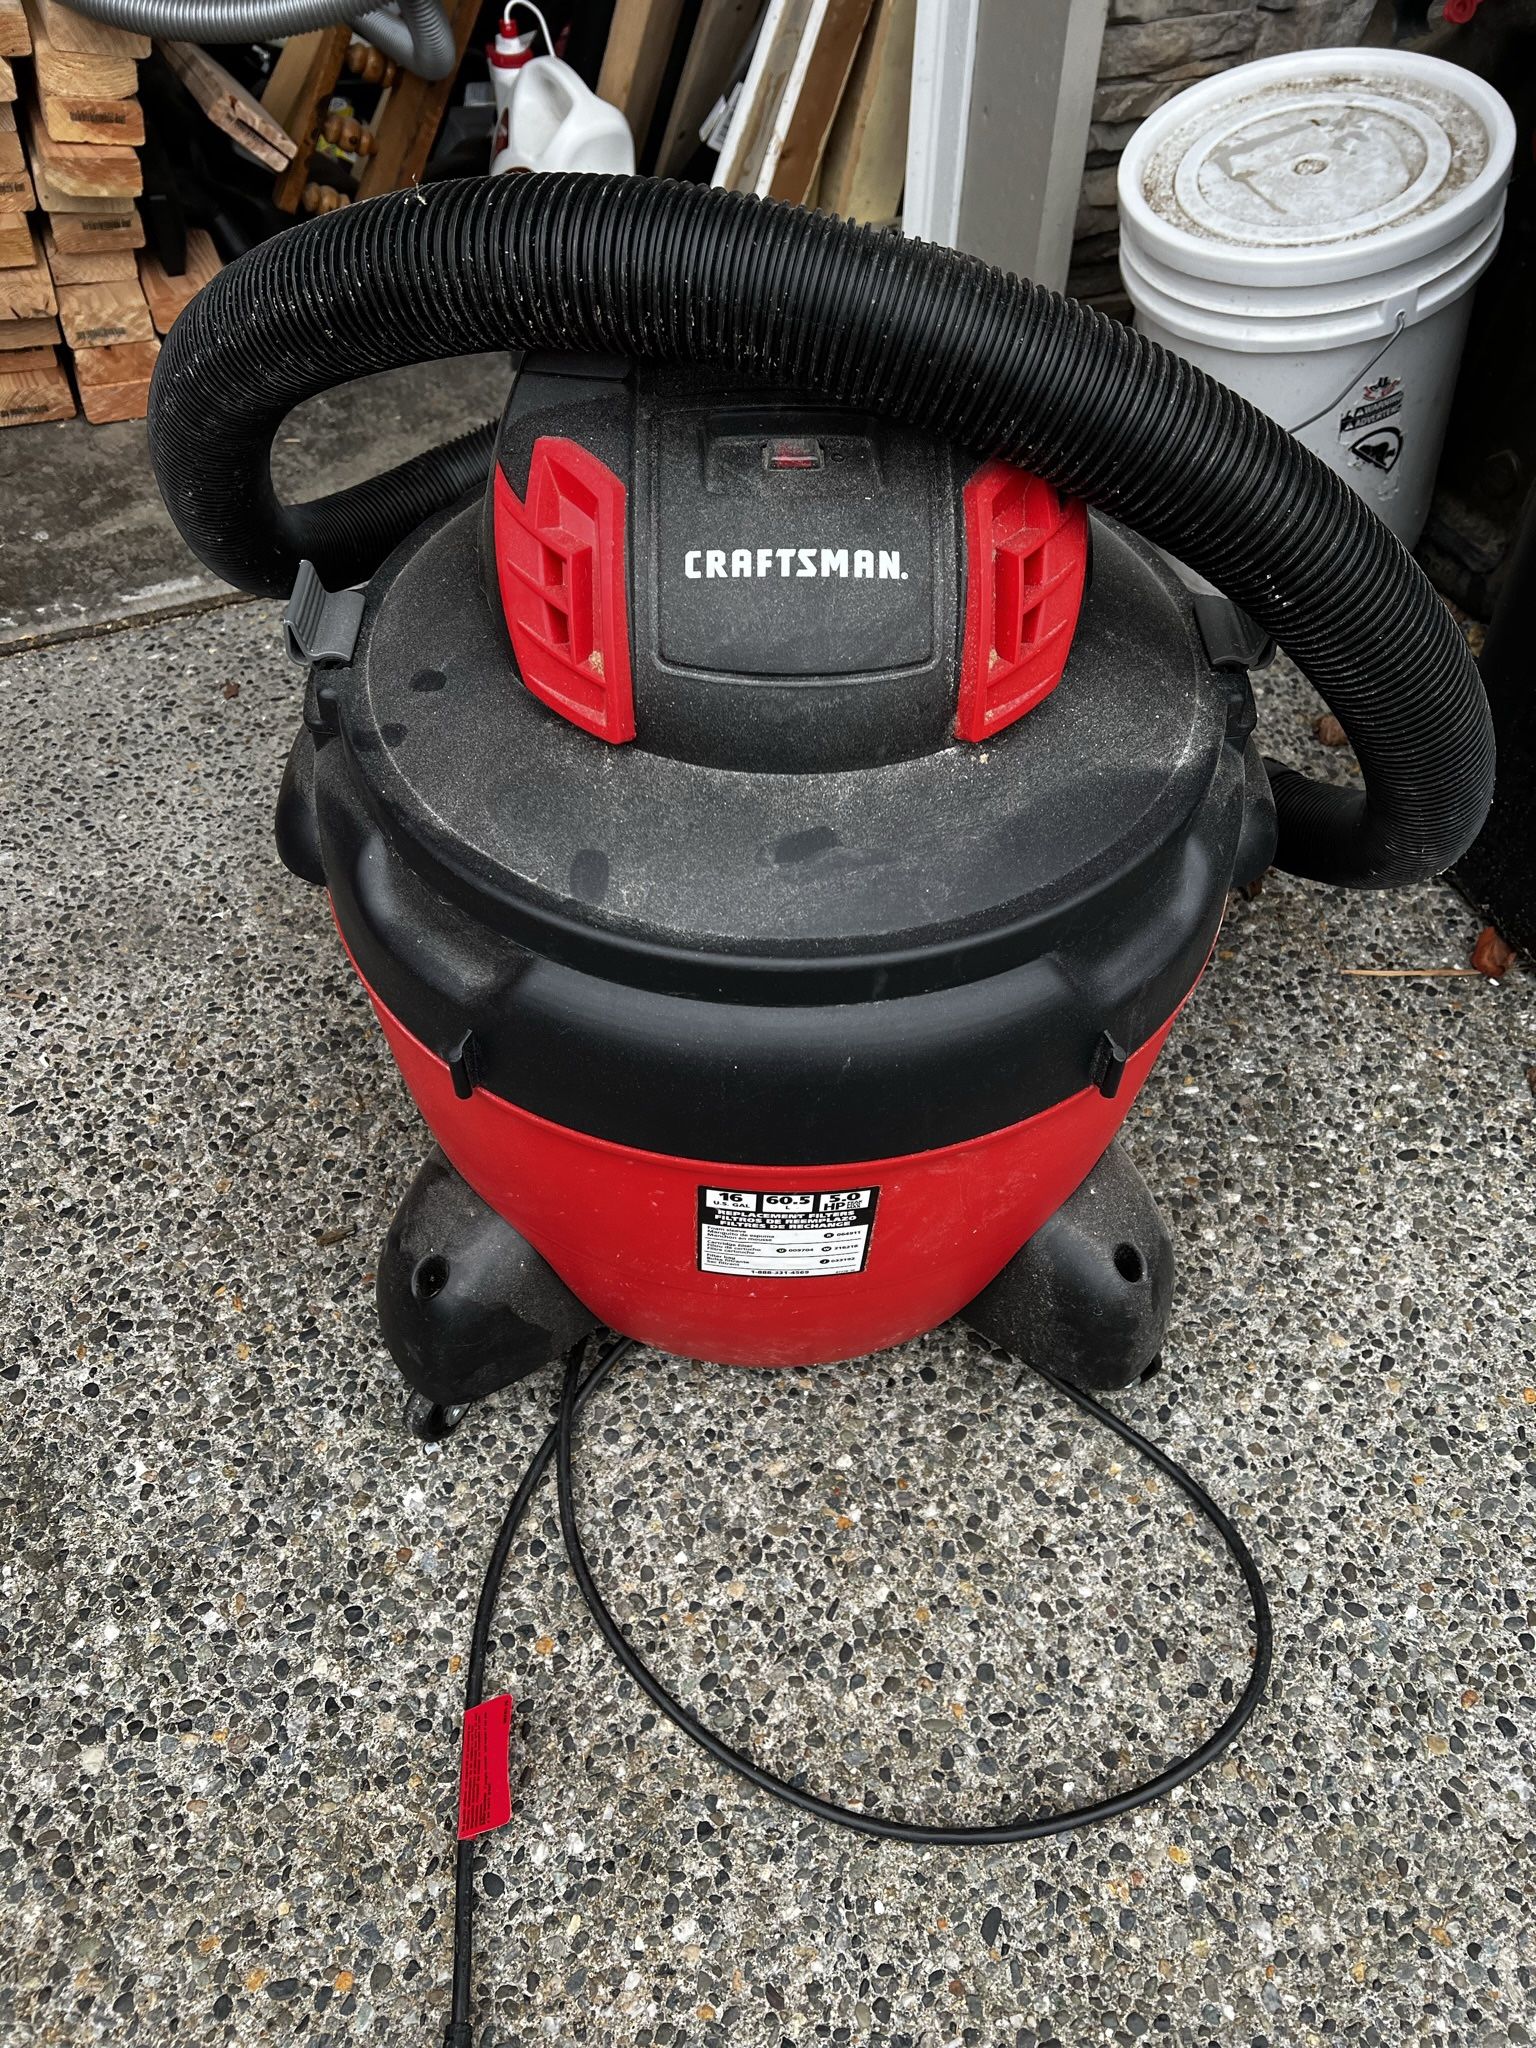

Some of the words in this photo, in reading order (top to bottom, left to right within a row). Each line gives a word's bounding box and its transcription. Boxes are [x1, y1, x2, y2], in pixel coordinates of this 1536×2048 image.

[719, 1193, 743, 1202] 16
[766, 1196, 810, 1205] 60.5
[829, 1193, 861, 1203] 5.0
[824, 1202, 846, 1210] HP
[717, 1209, 806, 1219] REPLACEMENT
[808, 1210, 855, 1219] FILTERS
[714, 1214, 763, 1224] FILTROS
[785, 1215, 857, 1224] REEMPLAZO
[720, 1220, 766, 1229] FILTRES
[789, 1221, 851, 1229] RECHANGE
